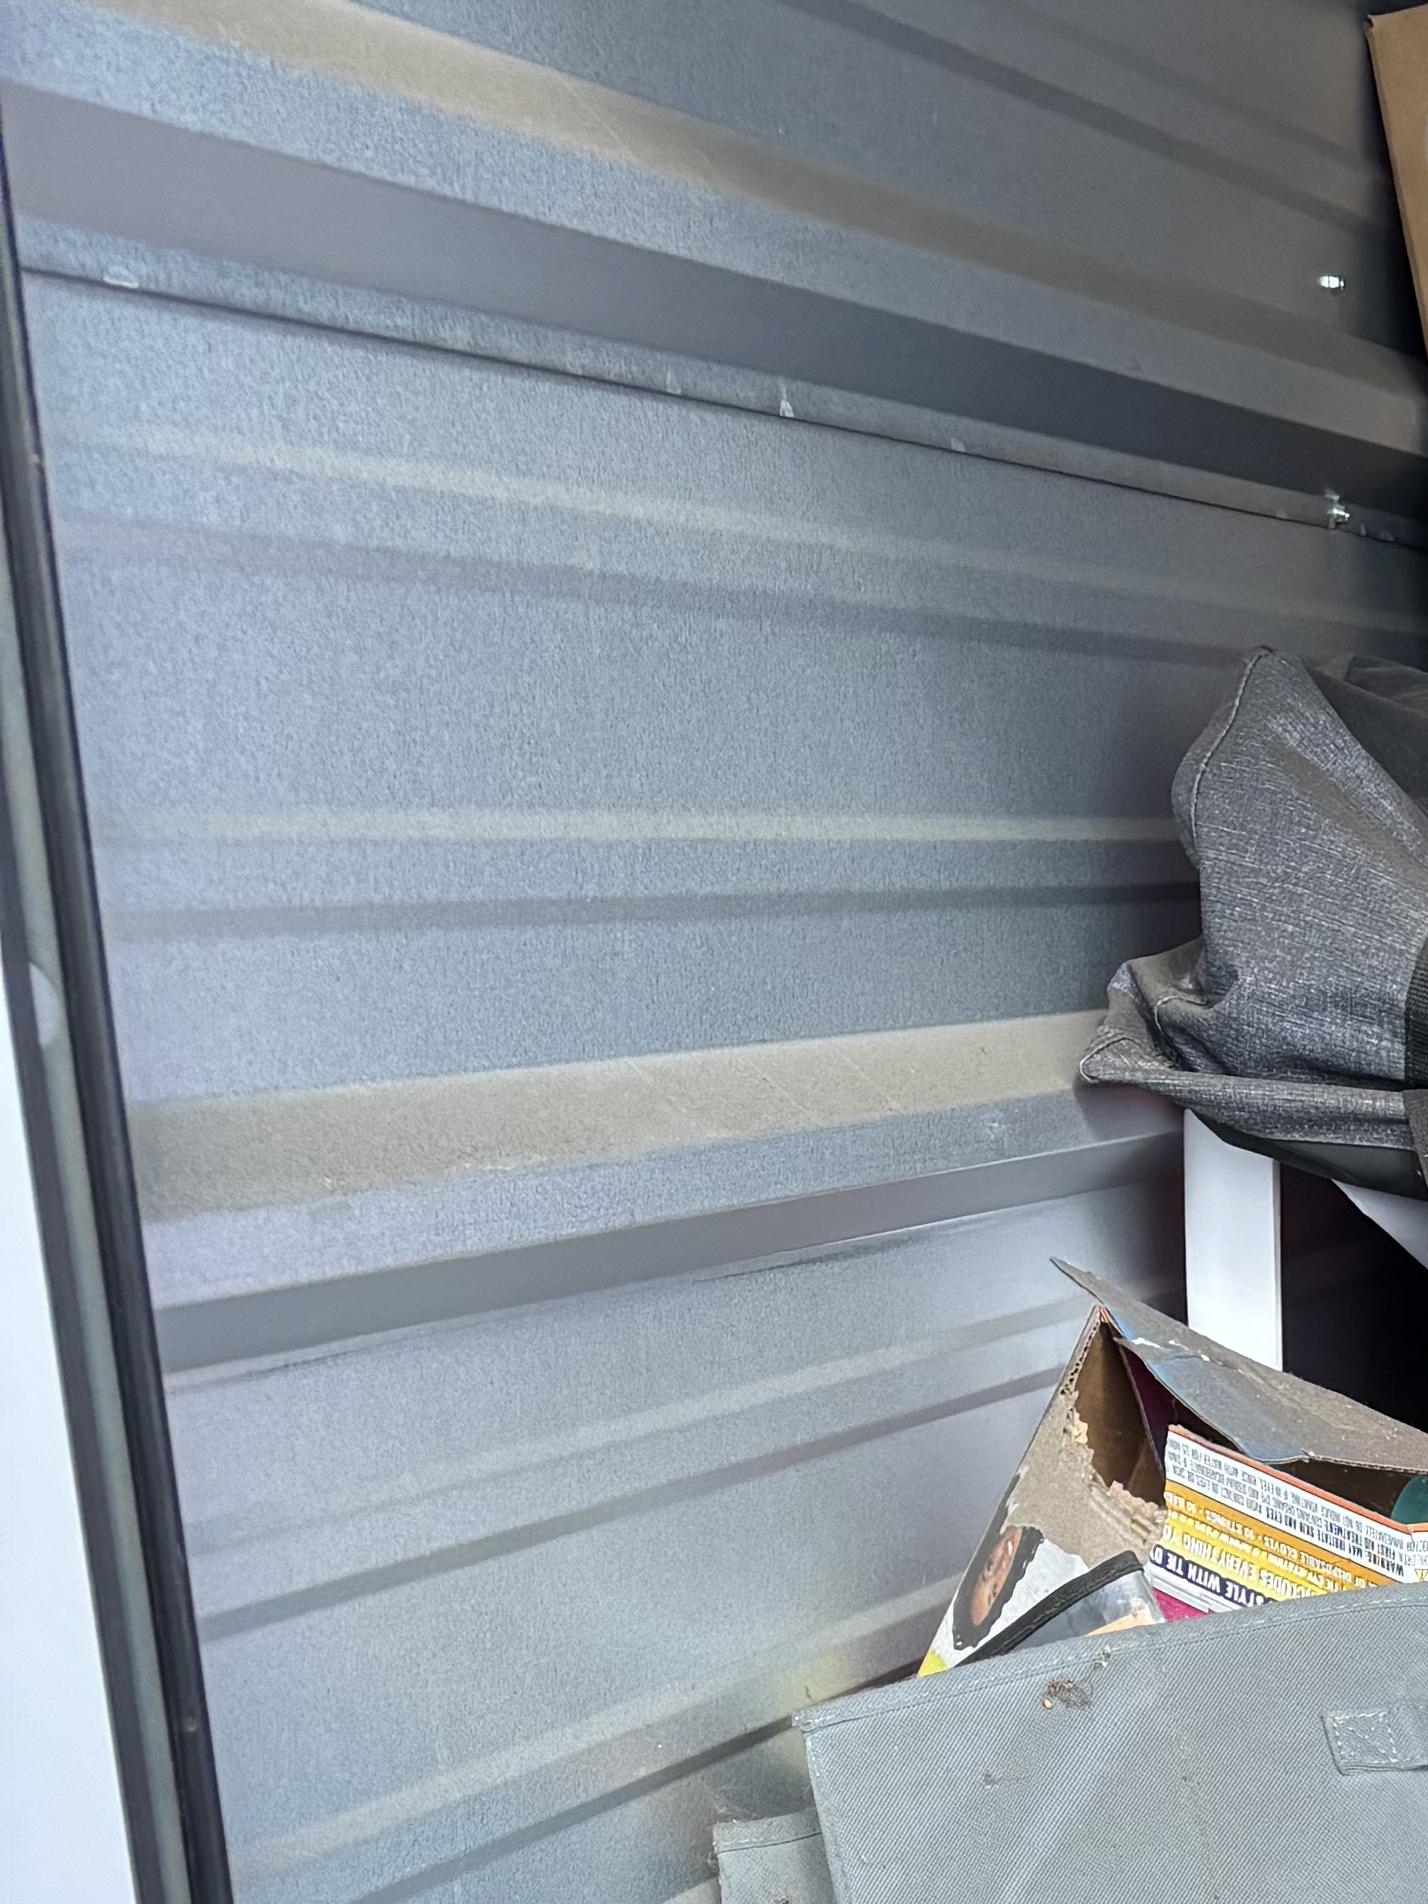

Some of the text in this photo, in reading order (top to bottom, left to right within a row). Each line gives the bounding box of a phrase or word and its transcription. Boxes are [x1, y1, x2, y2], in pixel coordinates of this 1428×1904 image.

[1168, 1552, 1183, 1575] TIE
[1183, 1533, 1255, 1583] EVERYTHING
[1366, 1550, 1403, 1576] WARNING:
[1188, 1563, 1220, 1593] WITH
